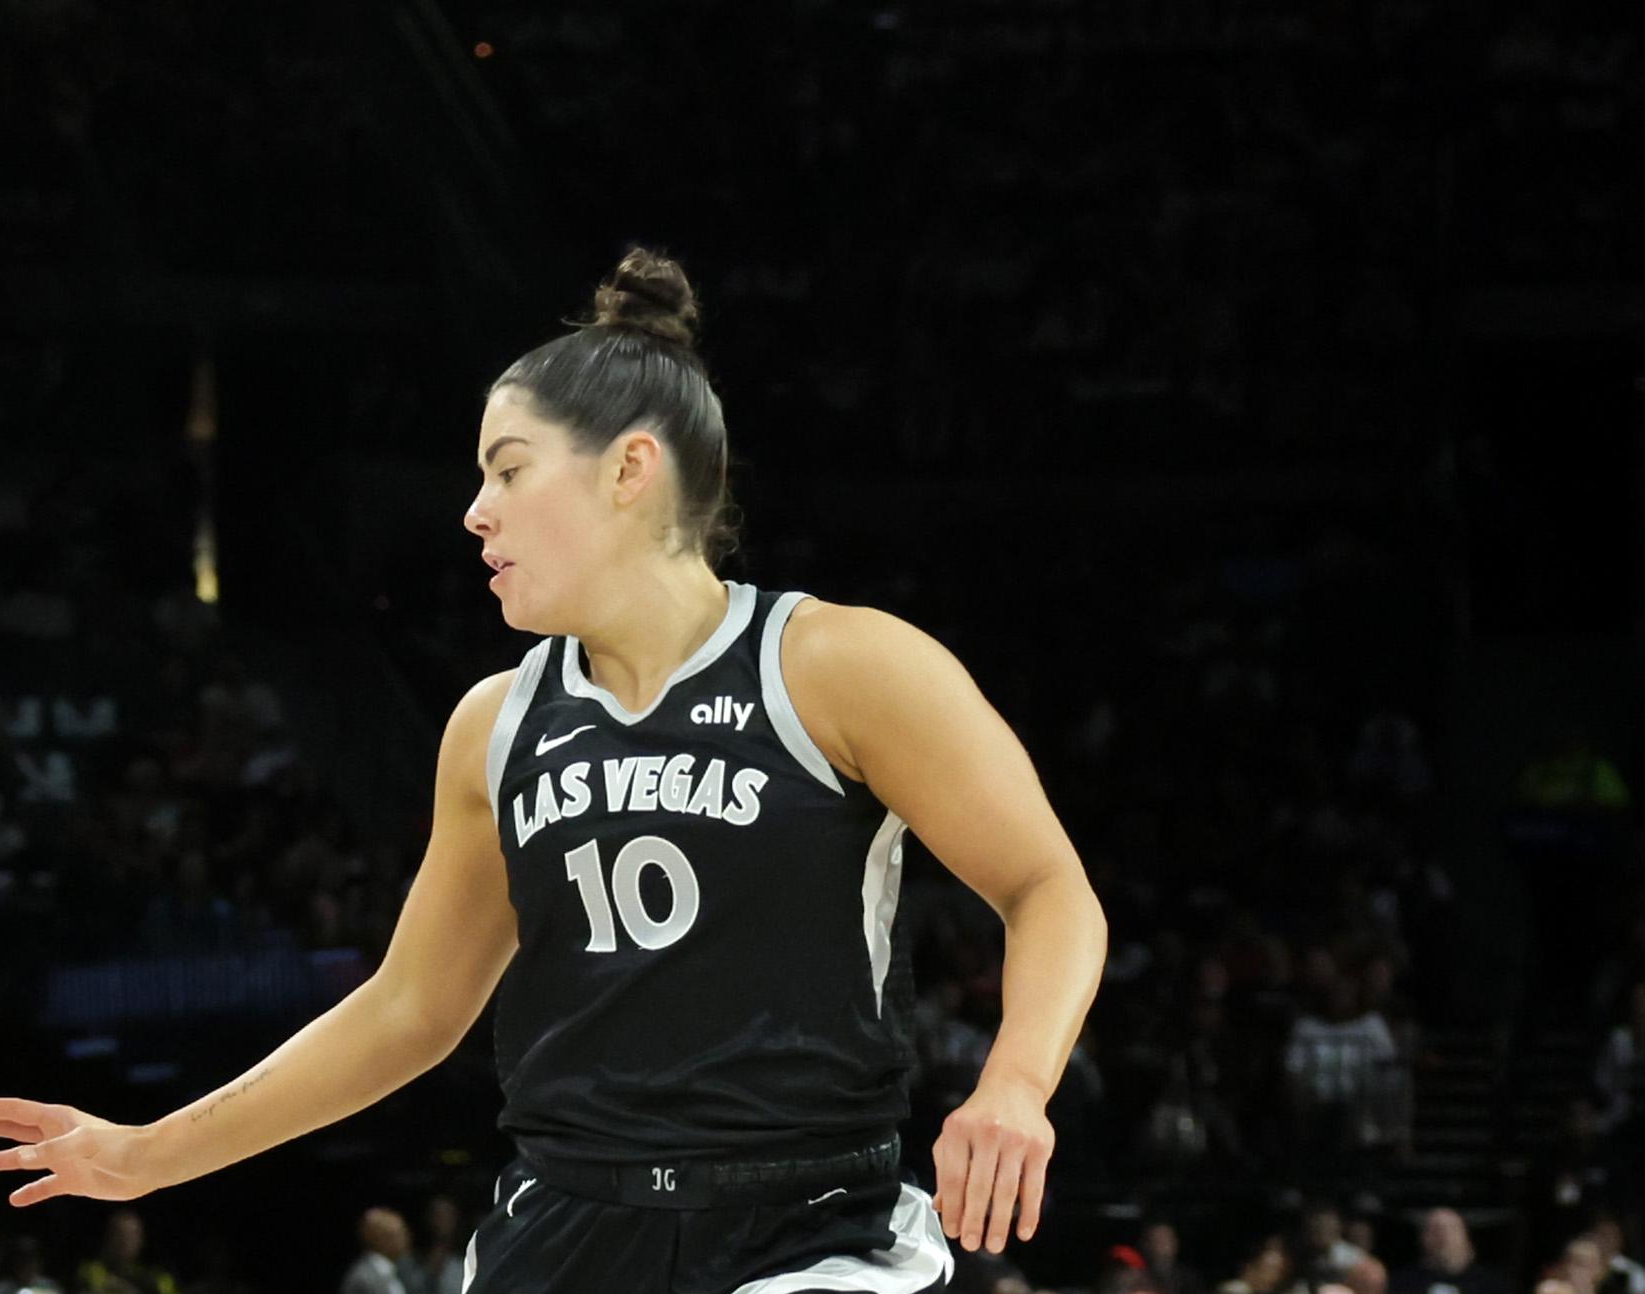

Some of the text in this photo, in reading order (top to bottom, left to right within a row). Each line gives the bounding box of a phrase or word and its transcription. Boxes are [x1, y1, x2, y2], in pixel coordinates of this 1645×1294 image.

[690, 696, 754, 731] ally
[513, 754, 769, 848] LAS VEGAS
[565, 835, 700, 952] 10
